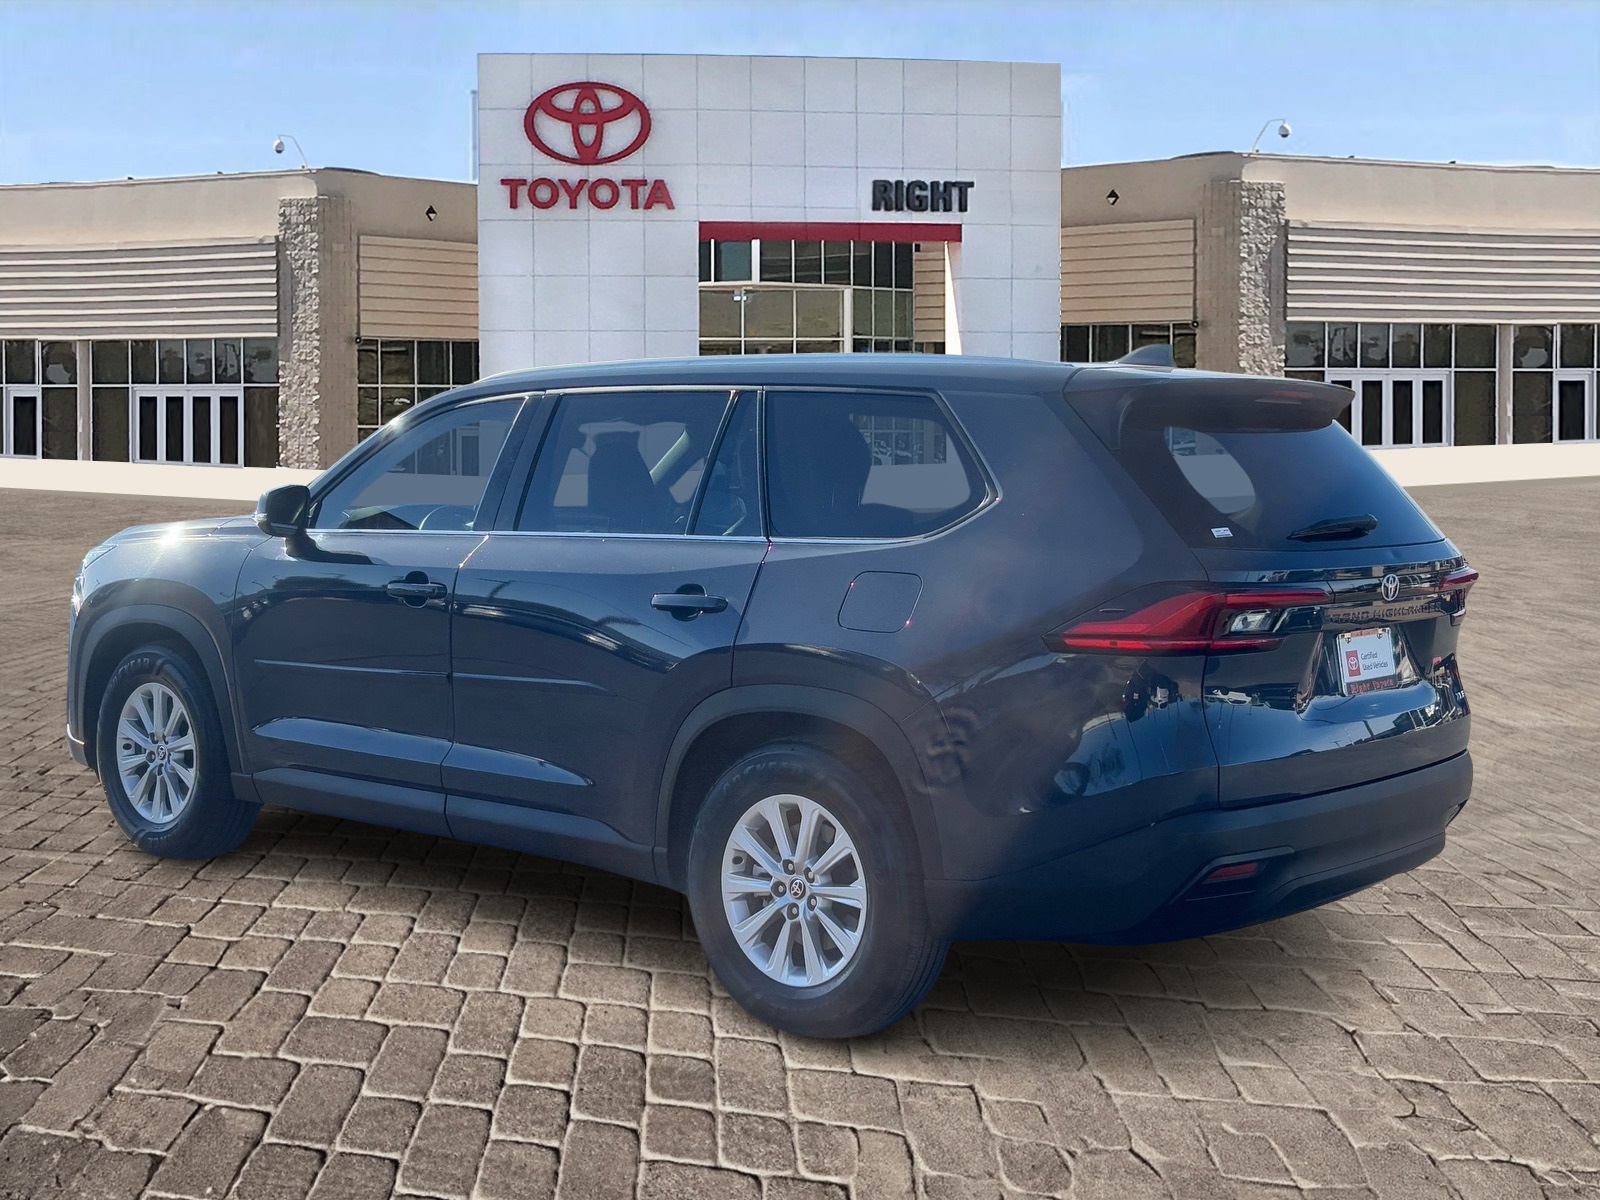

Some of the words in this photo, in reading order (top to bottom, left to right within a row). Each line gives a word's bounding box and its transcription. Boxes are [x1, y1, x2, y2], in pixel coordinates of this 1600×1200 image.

[501, 178, 675, 210] TOYOTA
[872, 180, 974, 212] RIGHT
[1360, 651, 1378, 661] Certified
[1363, 663, 1373, 671] Used
[1373, 660, 1389, 670] Vehicles
